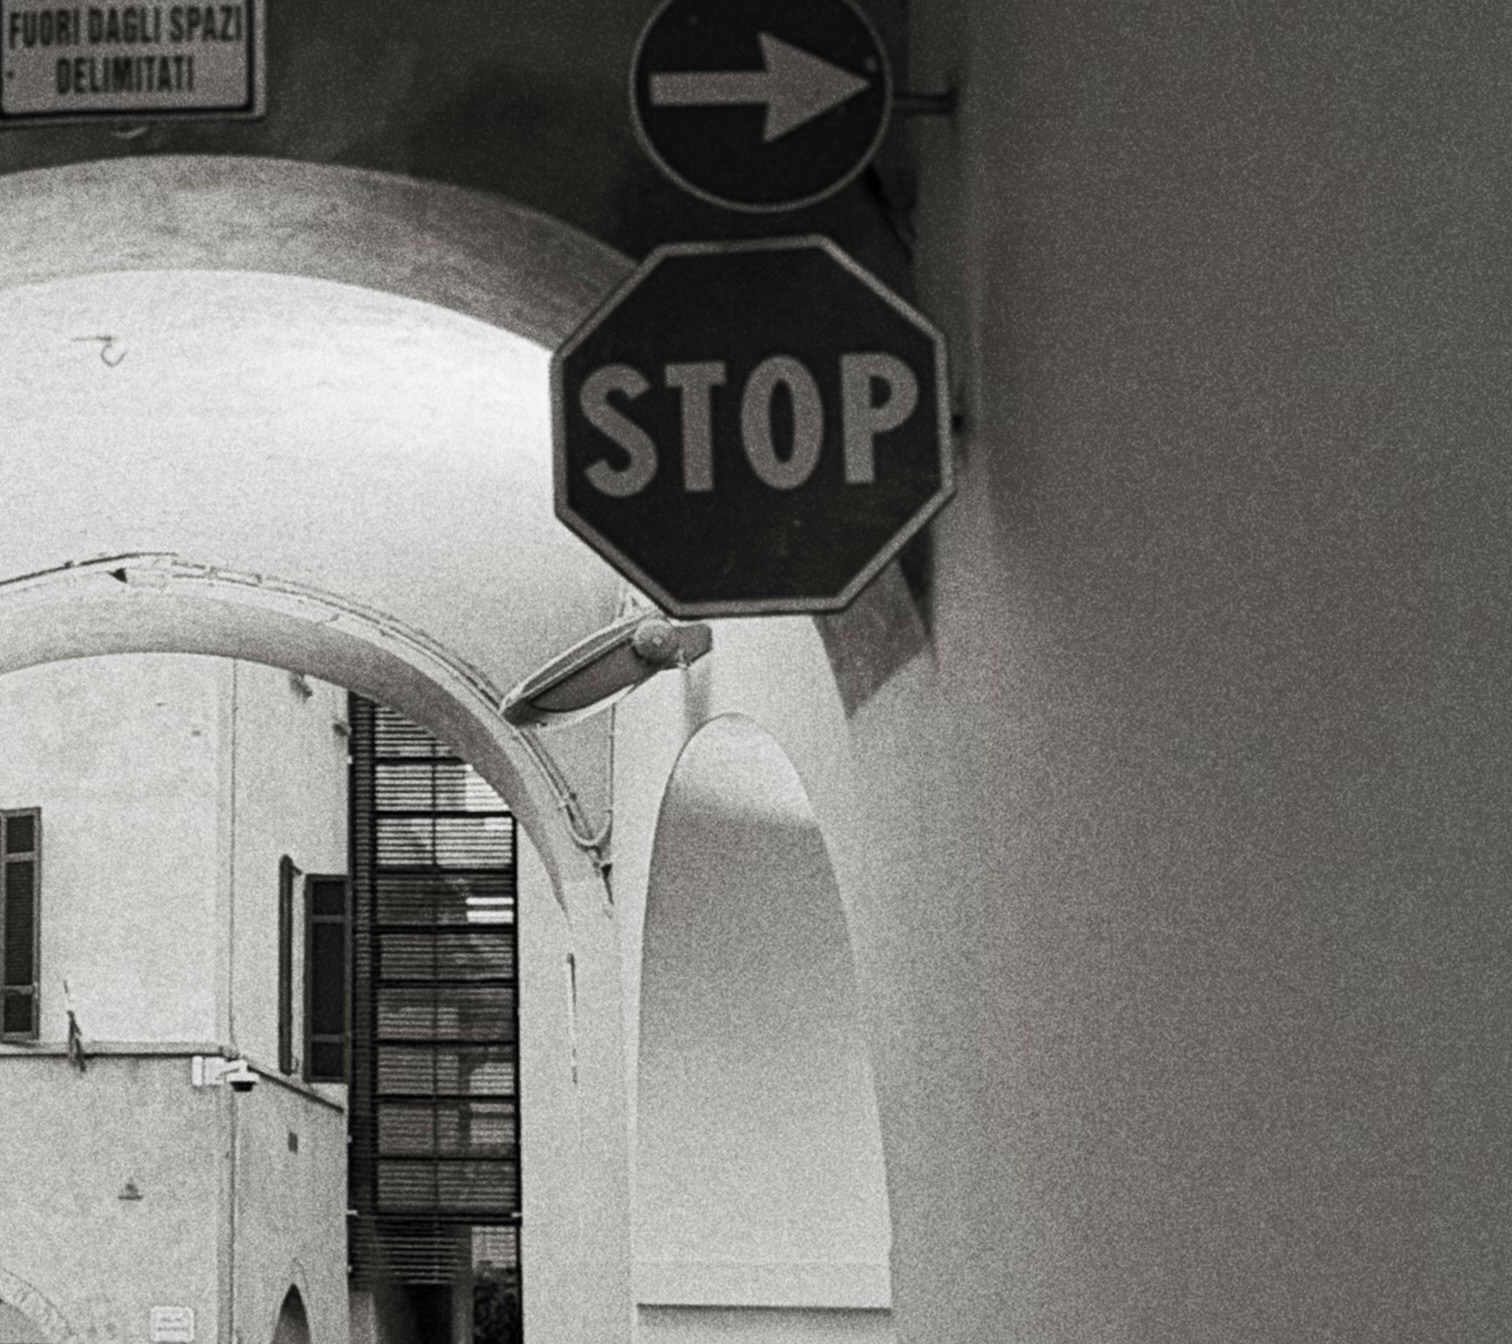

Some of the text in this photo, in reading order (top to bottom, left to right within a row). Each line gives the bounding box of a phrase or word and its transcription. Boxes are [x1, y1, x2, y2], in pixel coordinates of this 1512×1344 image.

[9, 5, 242, 49] FUORI DAGLI SPAZI
[56, 55, 194, 94] DELIMITATI
[580, 353, 919, 497] STOP
